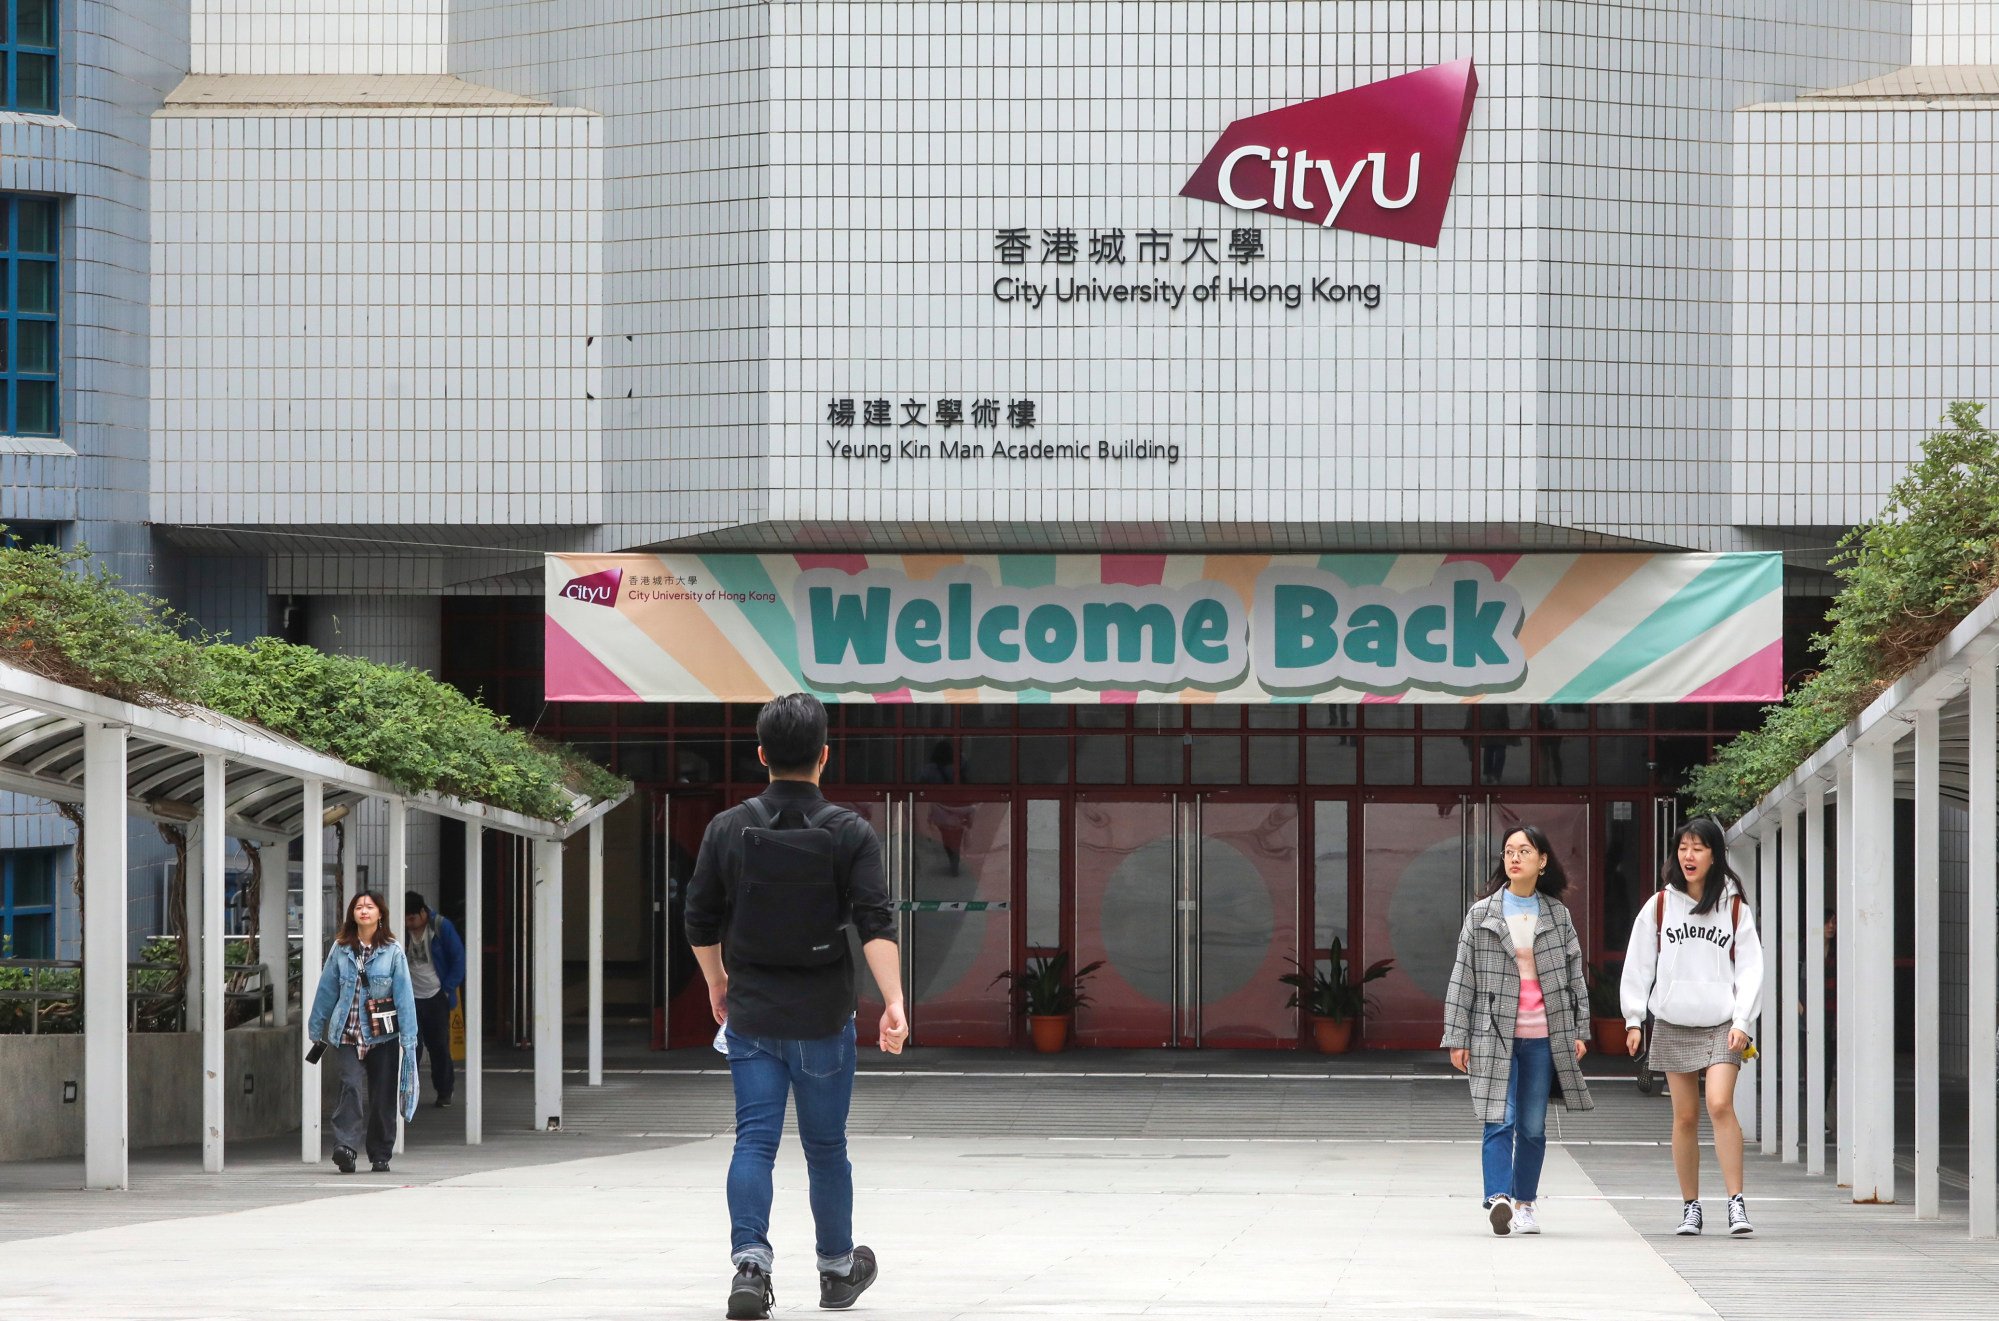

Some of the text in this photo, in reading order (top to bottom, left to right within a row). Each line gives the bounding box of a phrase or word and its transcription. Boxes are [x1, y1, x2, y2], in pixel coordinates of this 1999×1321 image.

[1217, 145, 1421, 227] CityU
[993, 228, 1266, 266] 香港城市大學
[993, 276, 1382, 309] City University of Hong Kong
[827, 398, 1037, 429] 楊建文學術樓
[827, 438, 1180, 464] Yeung Kin Man Academic Building
[566, 585, 611, 602] CityU
[628, 575, 698, 586] 香港城市大學
[628, 591, 775, 602] City University of Hong Kong
[808, 579, 1511, 669] Welcome Back
[1666, 922, 1731, 949] Splendid
